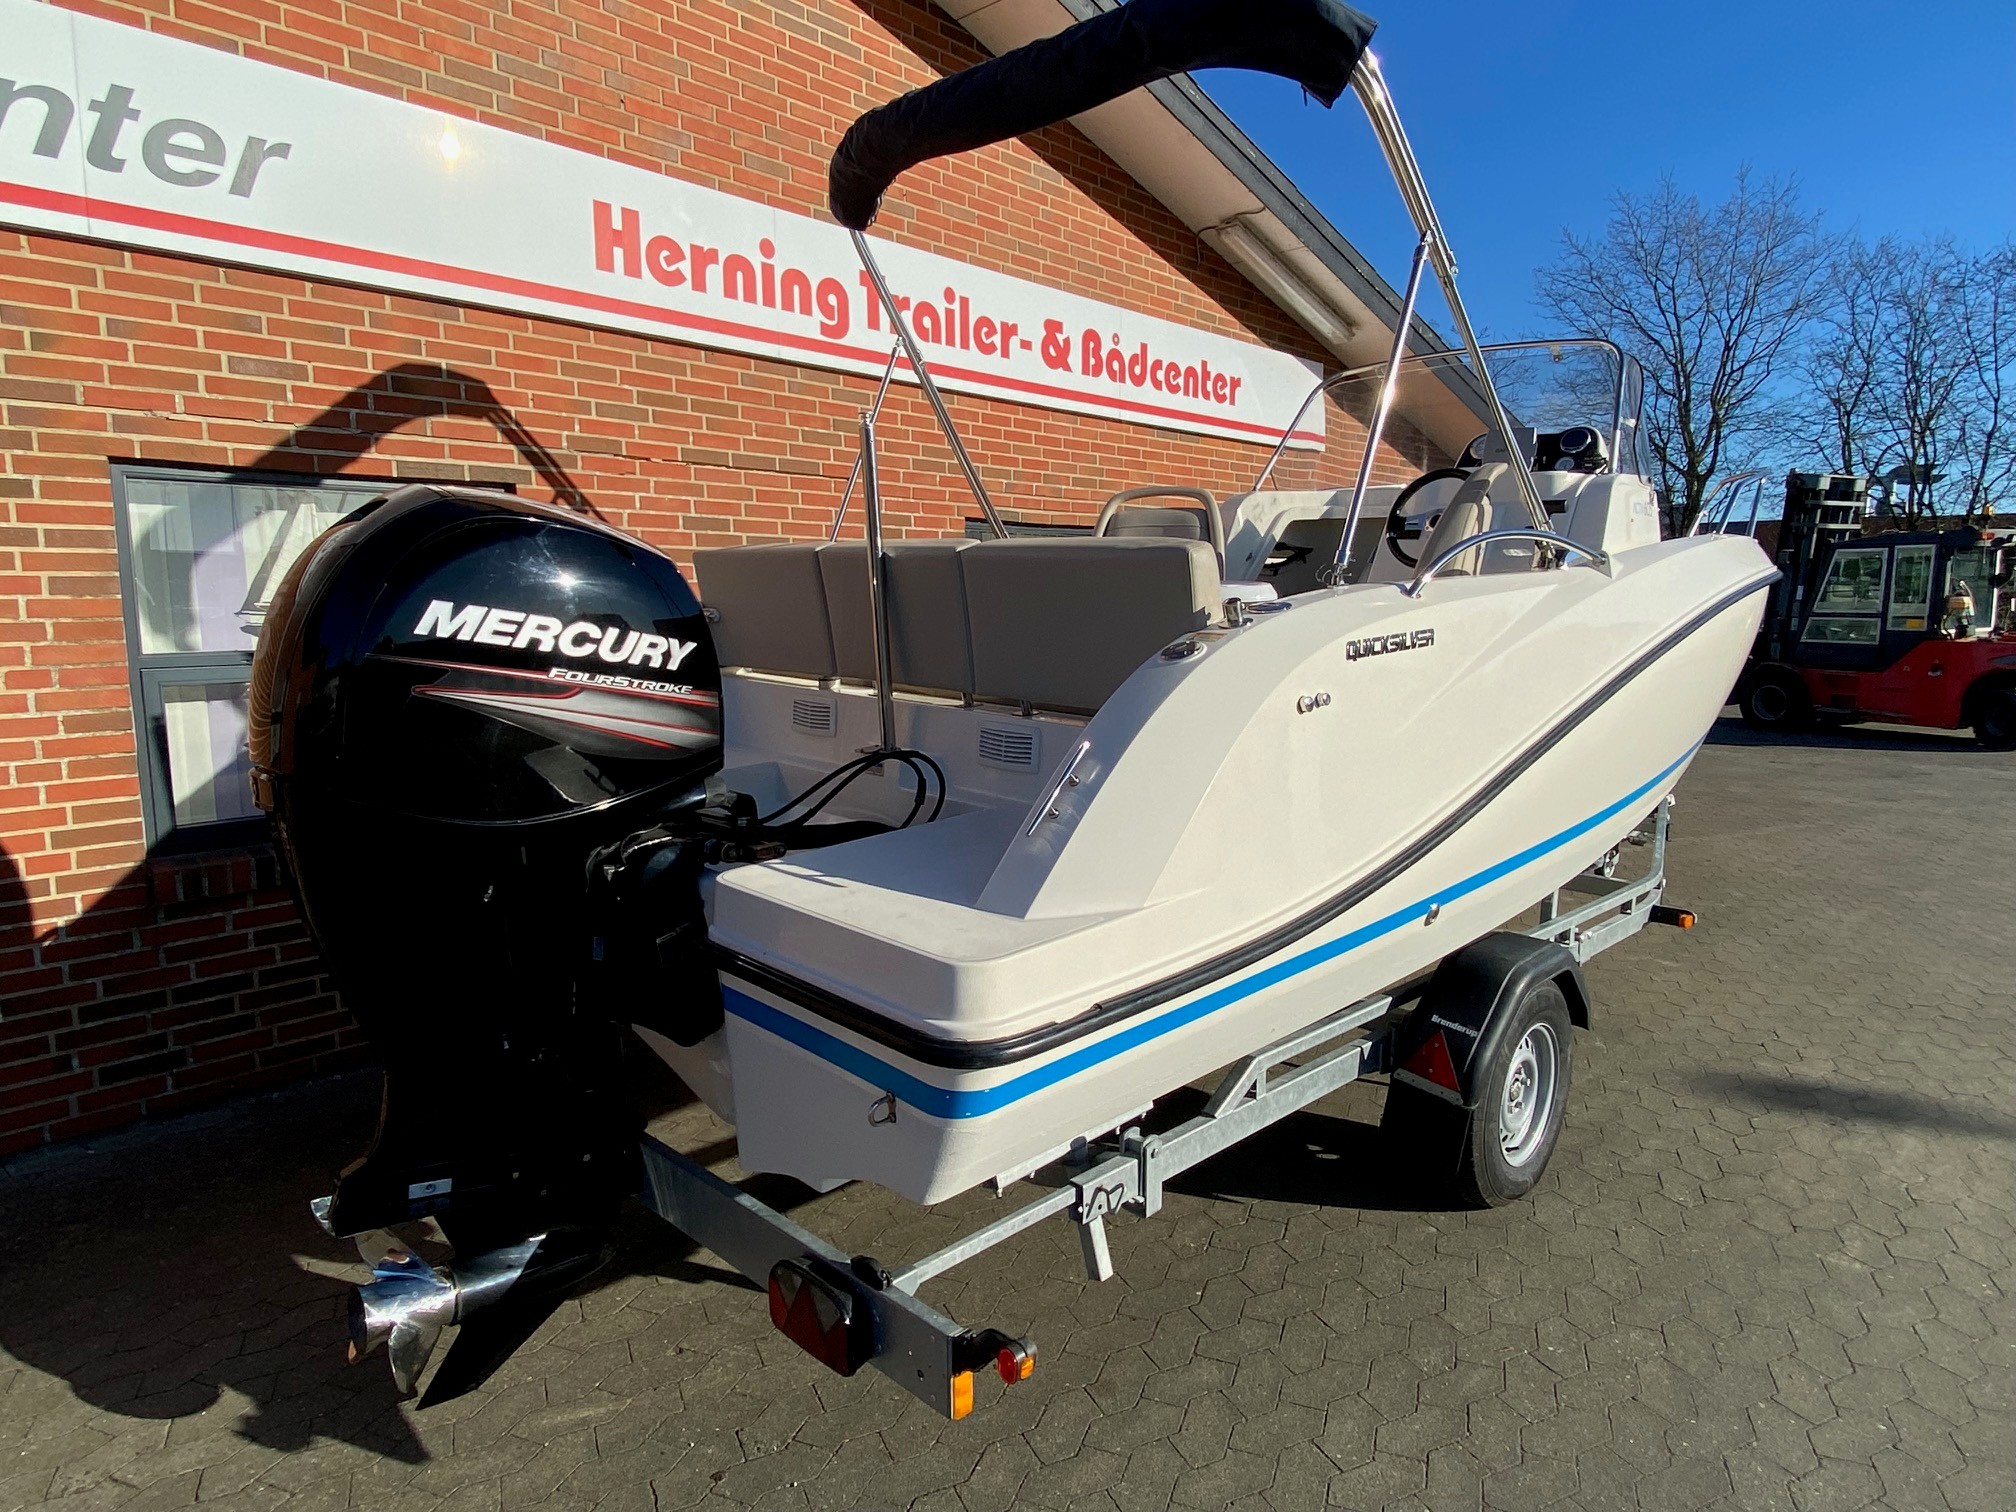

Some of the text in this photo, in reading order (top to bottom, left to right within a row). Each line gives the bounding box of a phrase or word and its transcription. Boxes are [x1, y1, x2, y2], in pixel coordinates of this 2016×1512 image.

[593, 199, 1242, 406] Herning Trailer- & Bådcenter
[413, 600, 698, 671] MERCURY
[1345, 628, 1435, 662] QUICKSILVER
[548, 667, 693, 695] FOURSTROKE
[1431, 1014, 1478, 1037] Brenderup
